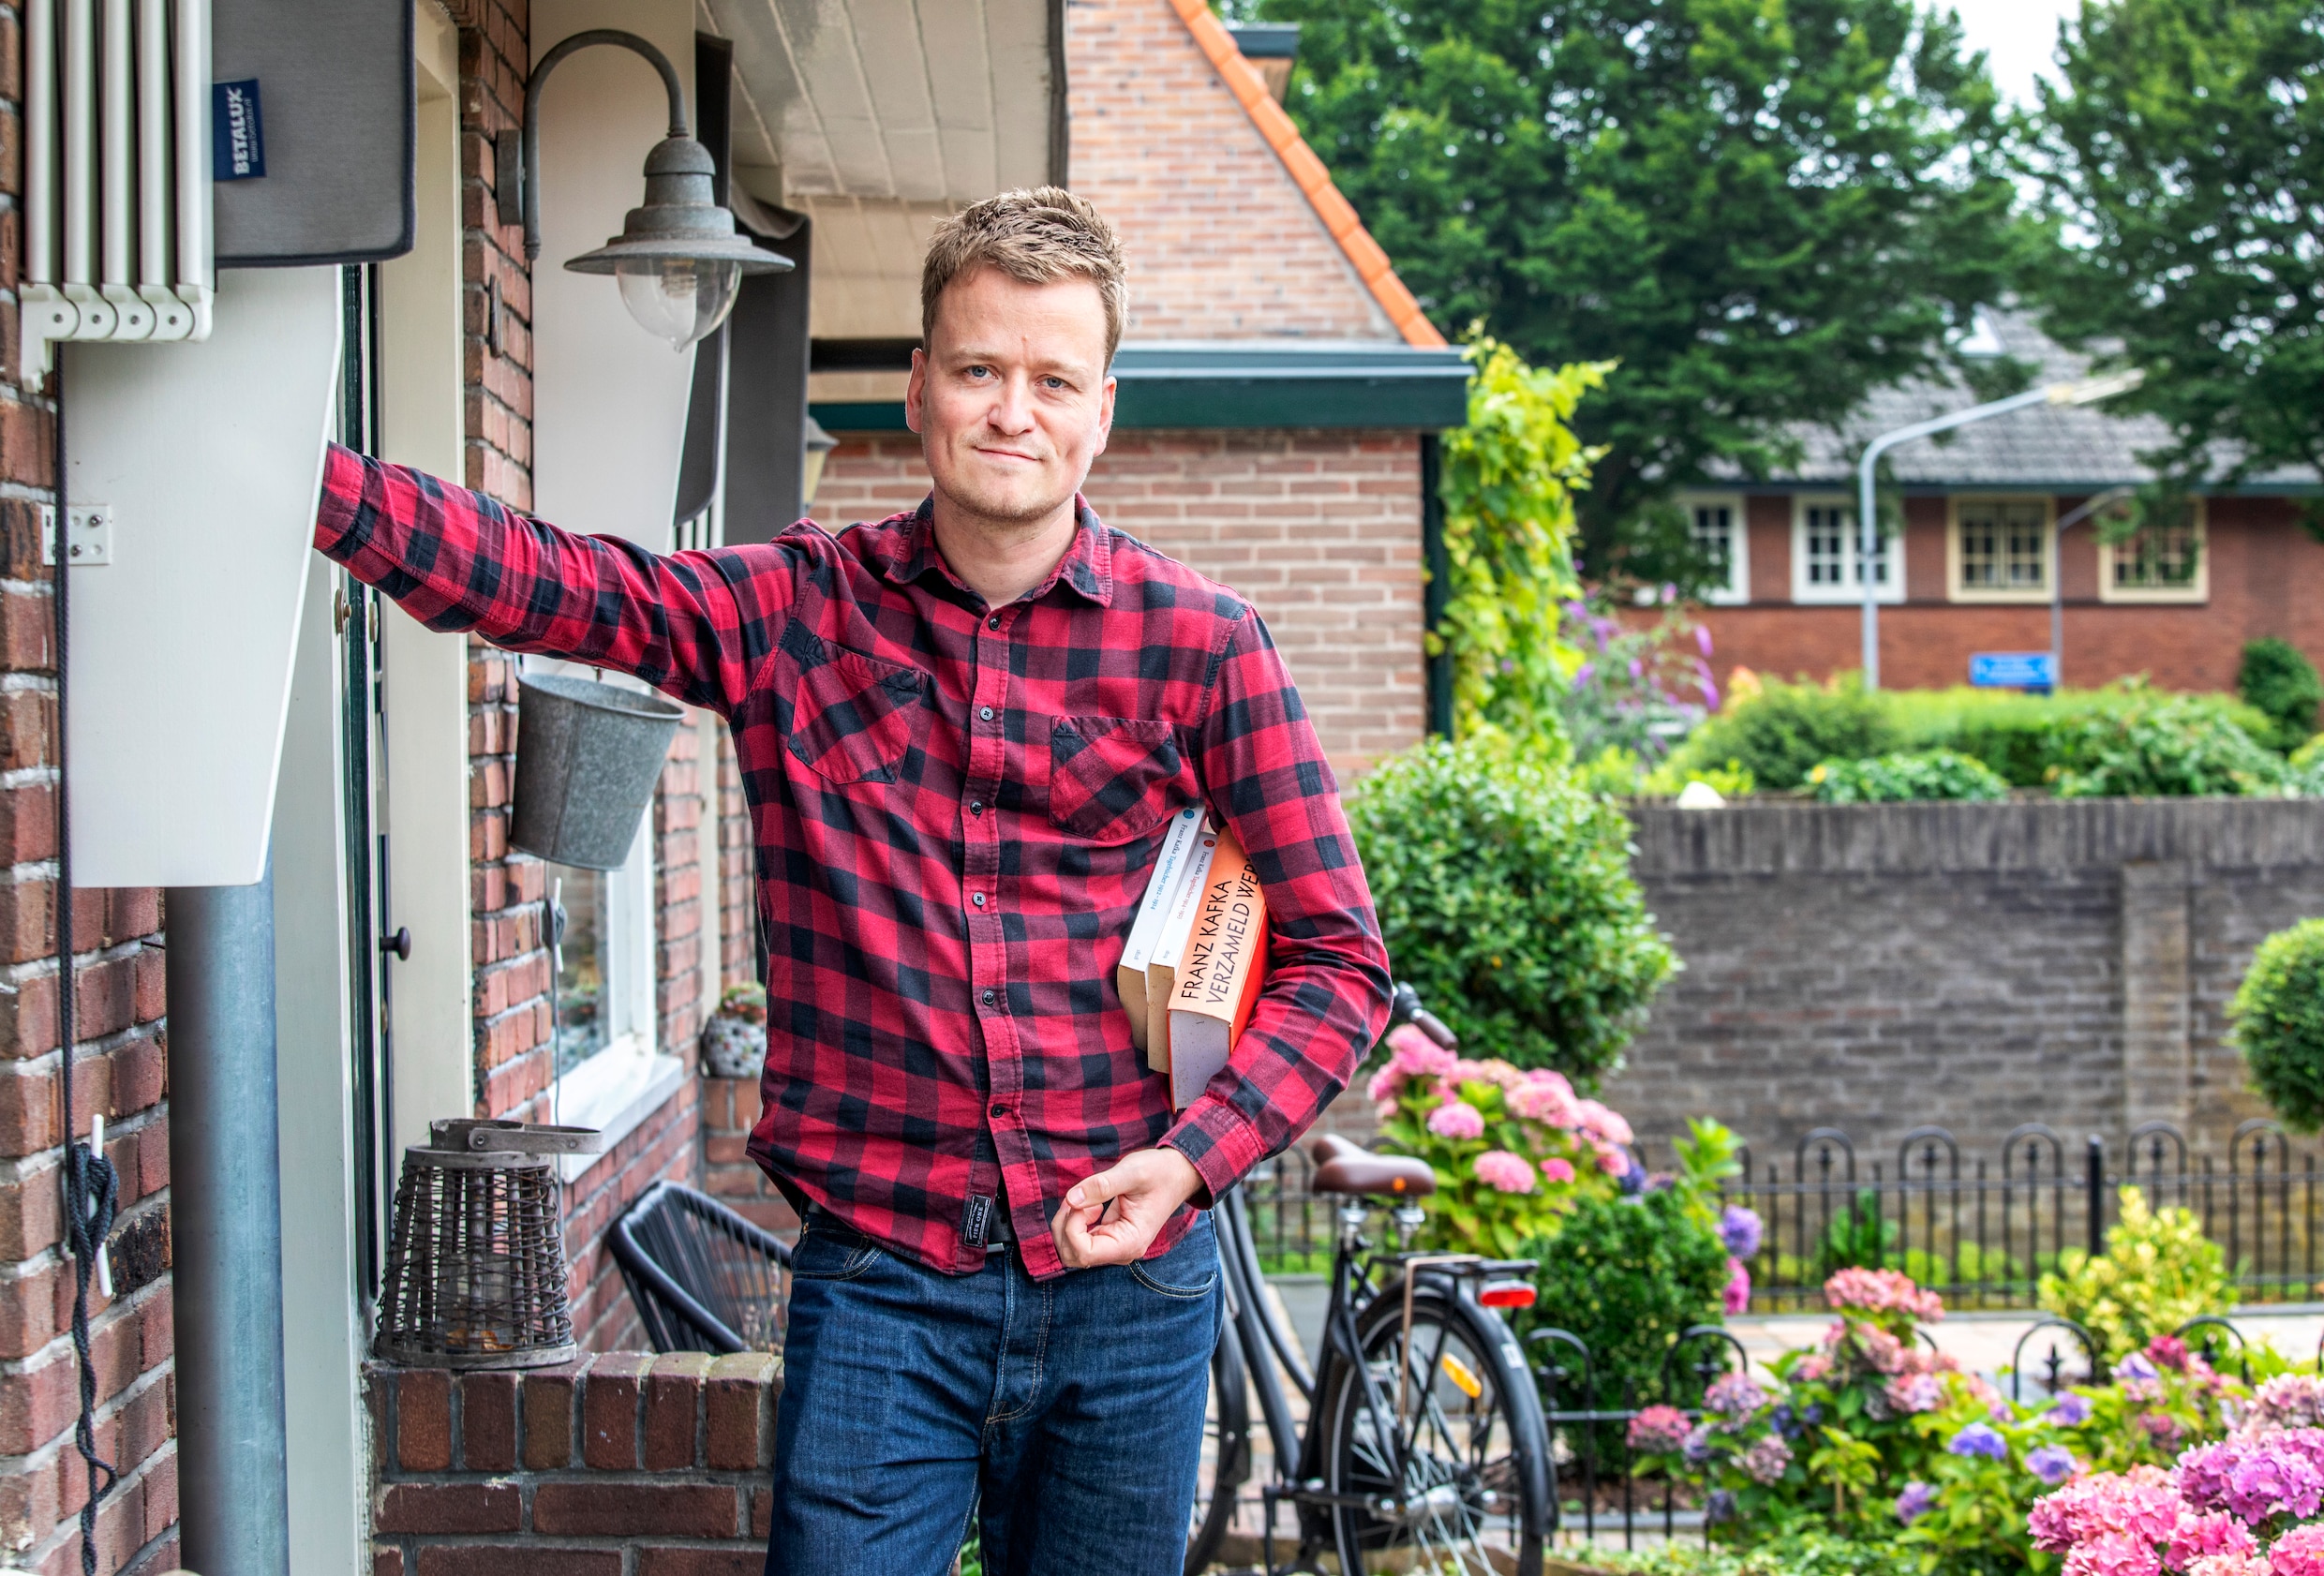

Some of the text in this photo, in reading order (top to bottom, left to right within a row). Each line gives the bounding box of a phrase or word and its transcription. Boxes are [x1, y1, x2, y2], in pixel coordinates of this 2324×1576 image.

[226, 86, 250, 174] BETALUX
[1178, 824, 1187, 840] Franz
[1172, 840, 1182, 854] Kafka
[1199, 852, 1209, 863] Franz
[1161, 855, 1176, 885] Tagebücher
[1195, 863, 1204, 875] Kafka
[1181, 880, 1232, 1000] FRANZ KAFKA
[1205, 902, 1250, 1004] VERZAMELD
